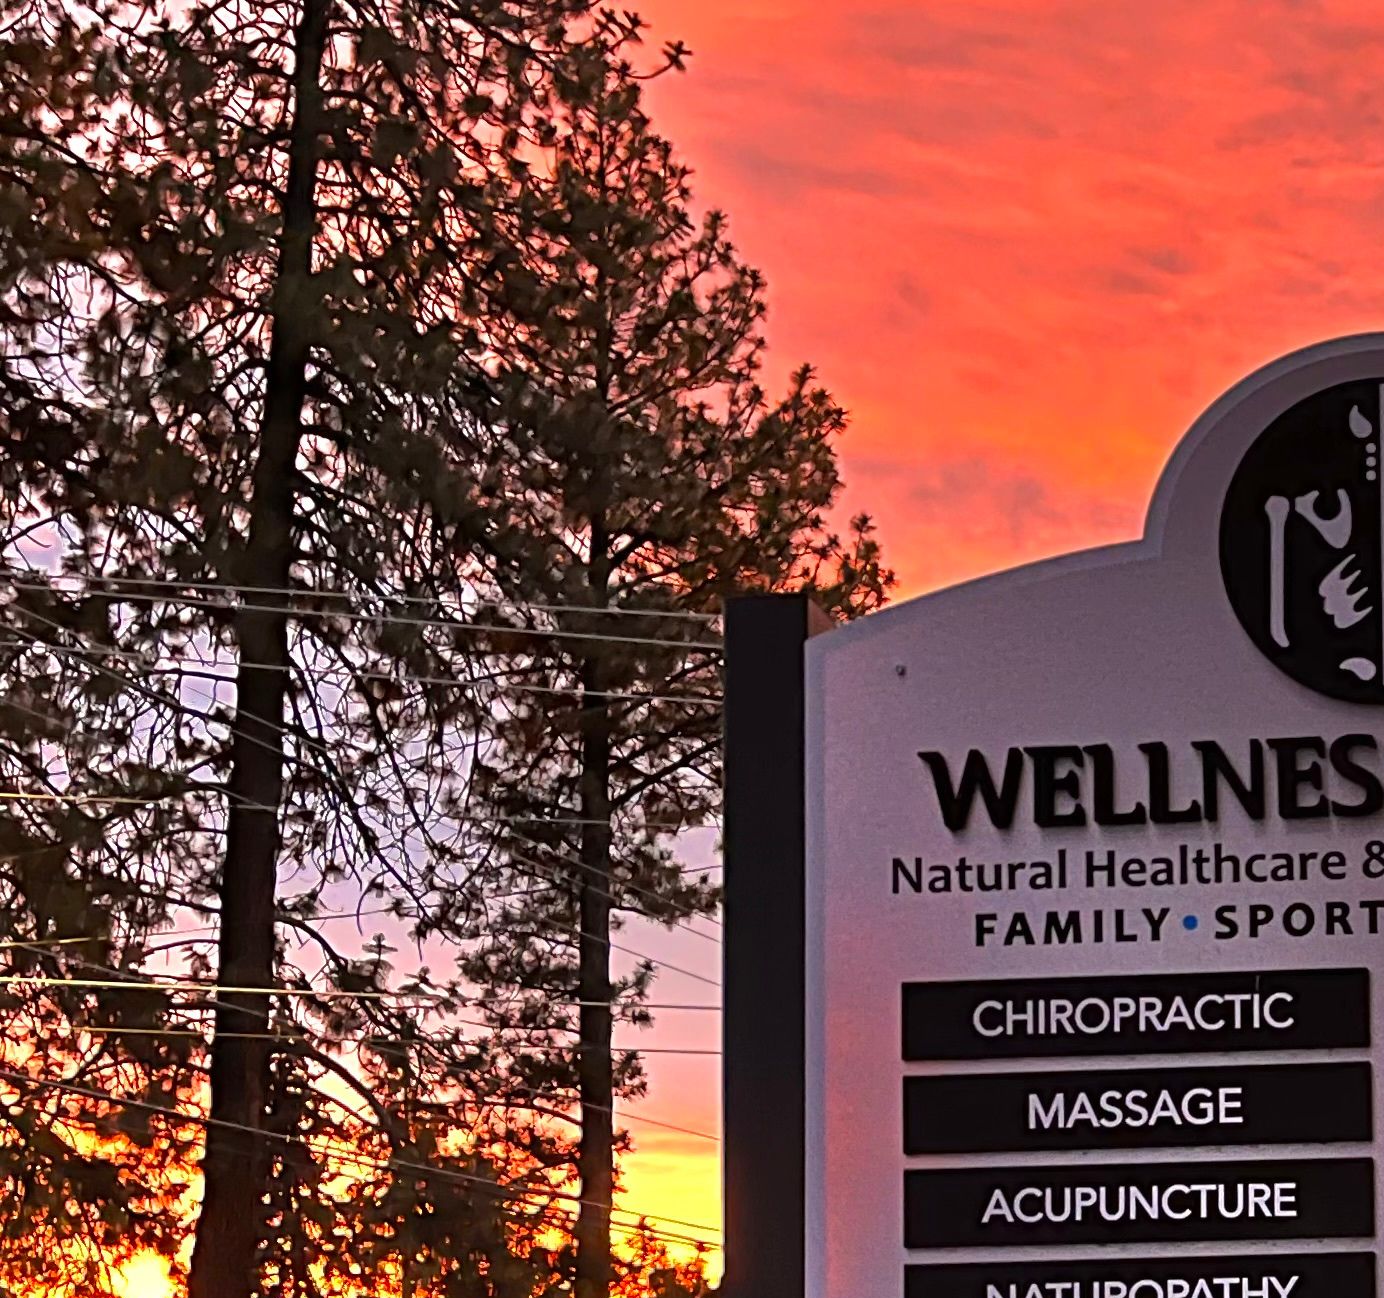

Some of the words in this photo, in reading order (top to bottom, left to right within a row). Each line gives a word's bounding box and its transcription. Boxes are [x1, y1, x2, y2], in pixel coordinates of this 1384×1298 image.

[892, 849, 1067, 894] Natural
[1086, 843, 1347, 888] Healthcare
[974, 907, 1171, 947] FAMILY
[973, 992, 1294, 1037] CHIROPRACTIC
[1028, 1087, 1244, 1130] MASSAGE
[982, 1182, 1298, 1224] ACUPUNCTURE
